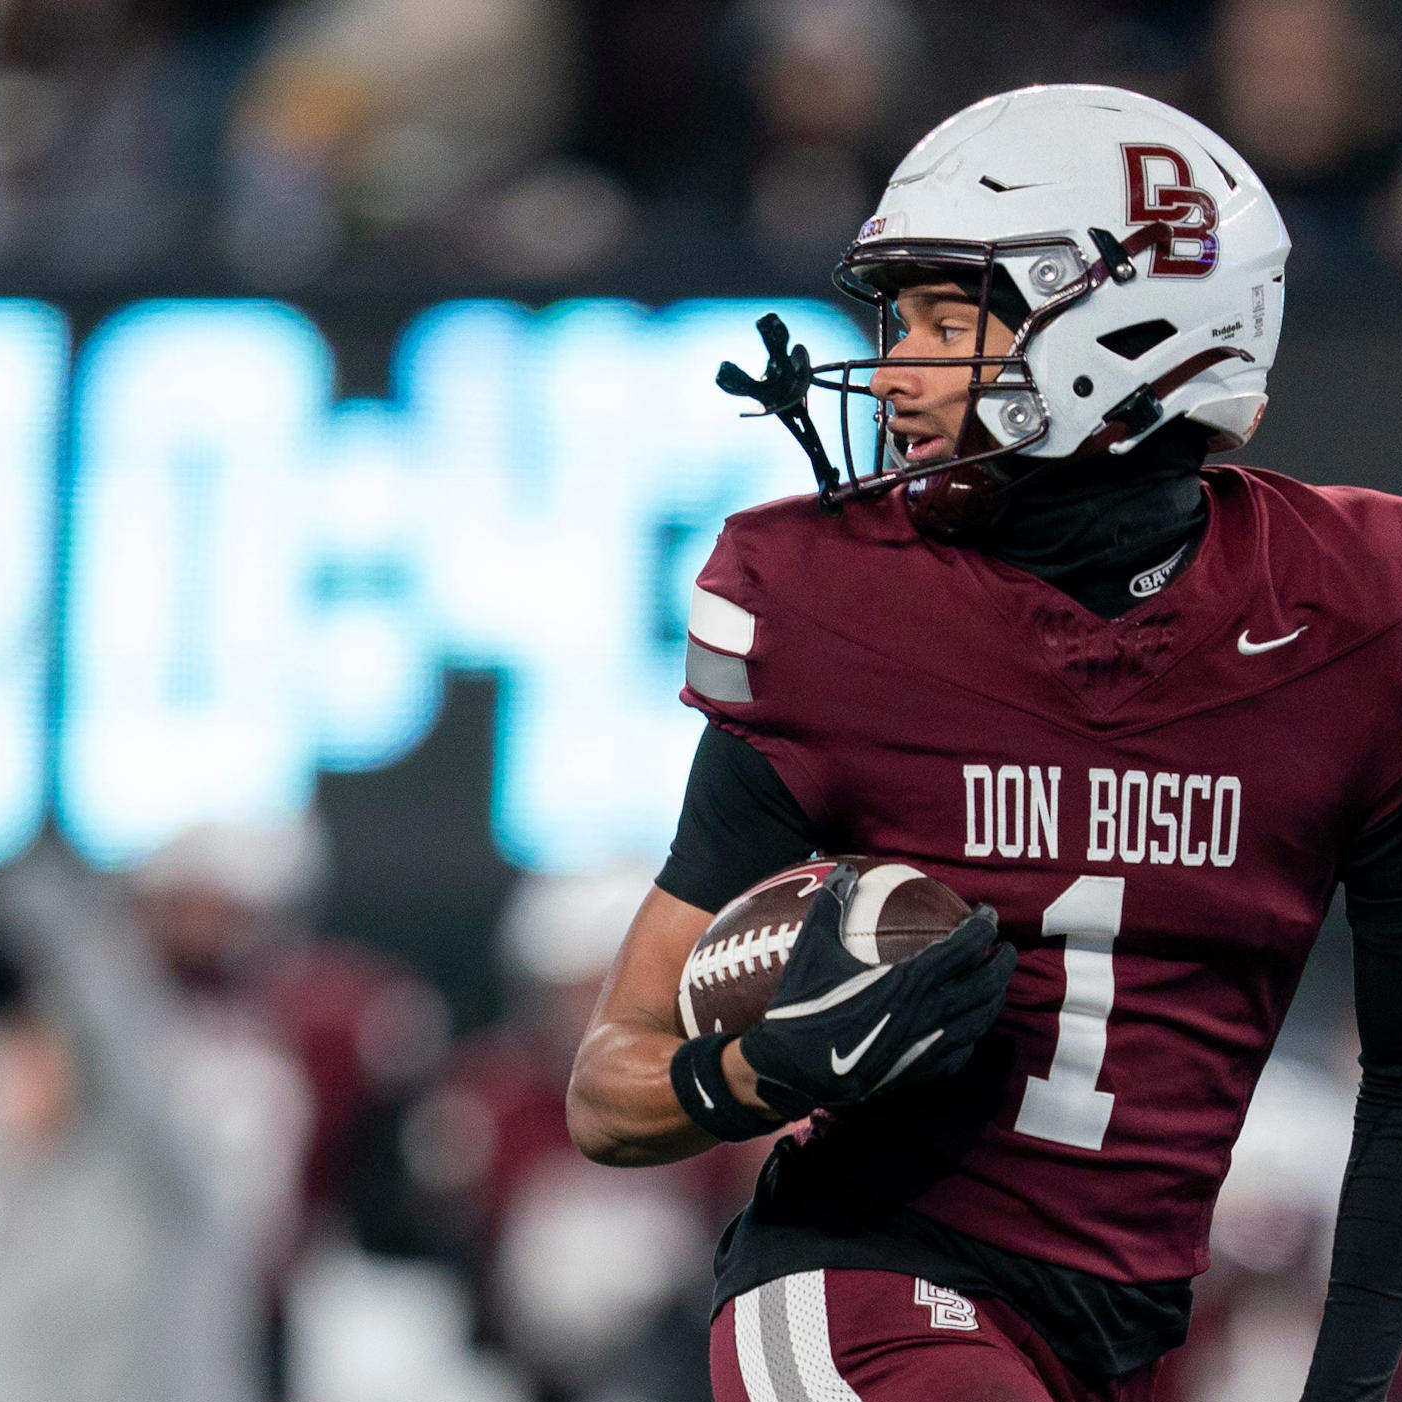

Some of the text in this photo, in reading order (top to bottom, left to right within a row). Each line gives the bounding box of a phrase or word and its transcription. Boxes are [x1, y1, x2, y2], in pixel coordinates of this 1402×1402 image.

[1120, 143, 1219, 278] DB
[963, 765, 1241, 867] DON BOSCO
[1014, 876, 1125, 1151] 1
